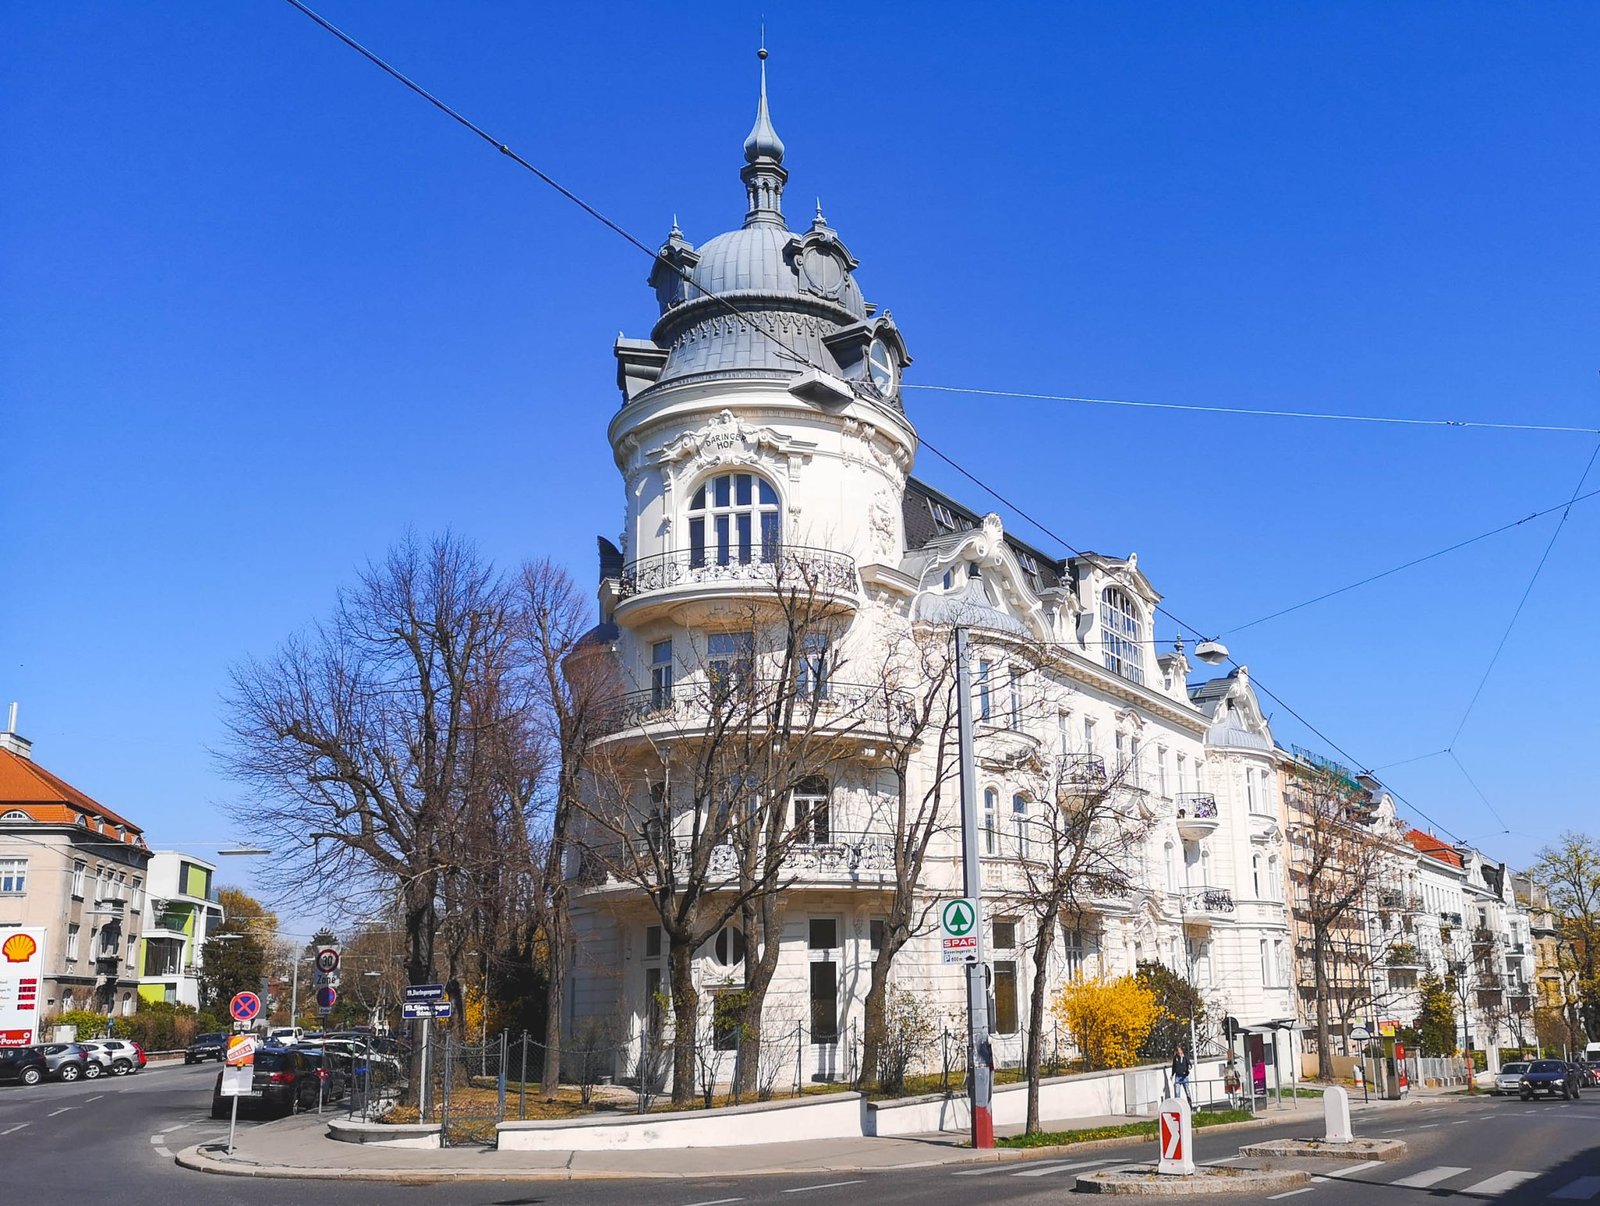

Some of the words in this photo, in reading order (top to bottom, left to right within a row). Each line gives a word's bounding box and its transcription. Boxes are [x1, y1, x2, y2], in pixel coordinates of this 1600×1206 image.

[705, 433, 746, 447] DARINGER
[716, 441, 734, 450] HOF
[943, 938, 976, 948] SPAR
[322, 955, 333, 967] 30
[317, 974, 336, 985] Zone
